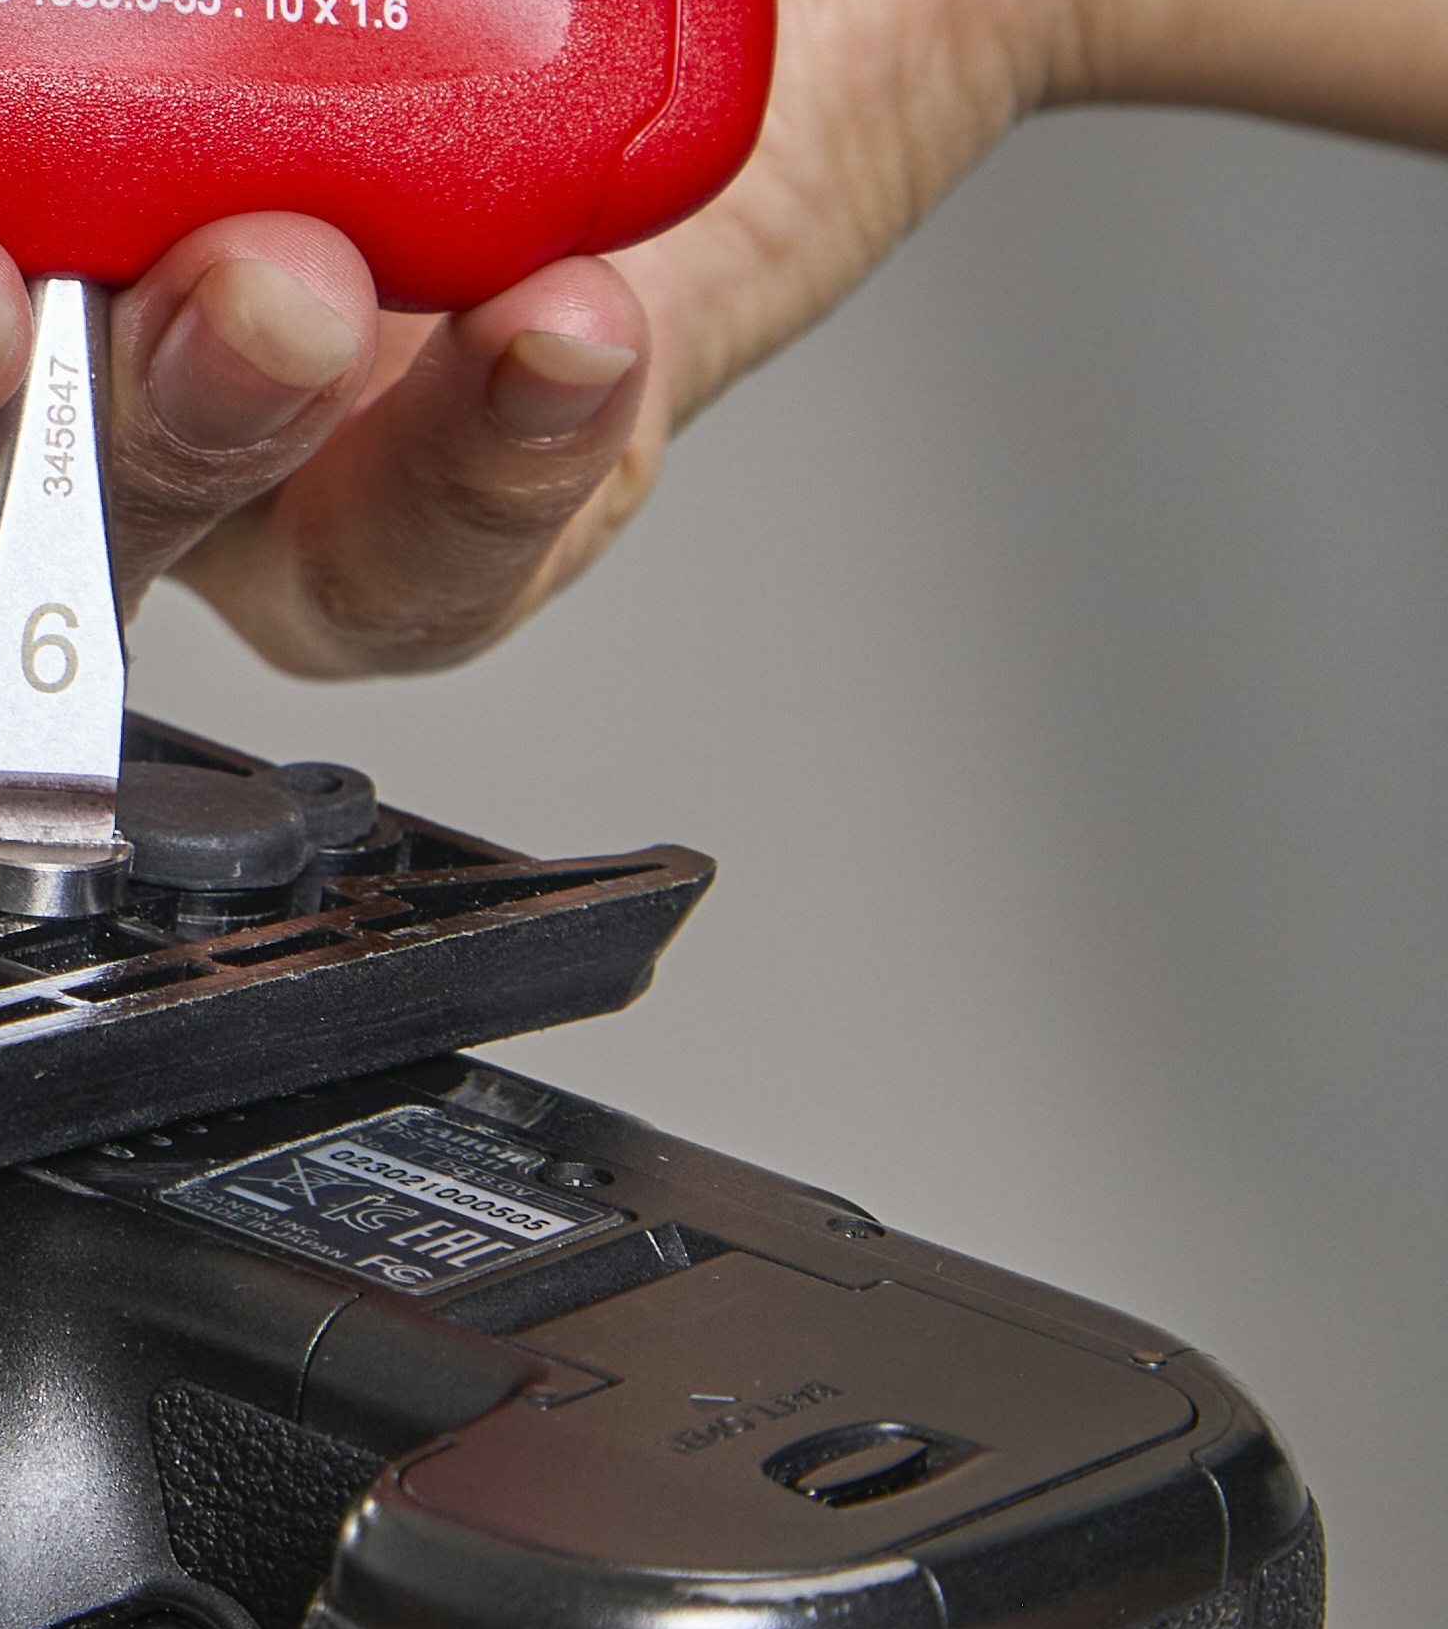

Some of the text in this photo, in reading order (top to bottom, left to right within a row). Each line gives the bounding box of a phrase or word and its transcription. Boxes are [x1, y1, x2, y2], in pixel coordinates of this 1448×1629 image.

[42, 355, 80, 499] 345647
[19, 601, 80, 695] 6
[329, 1150, 551, 1231] 023021000505
